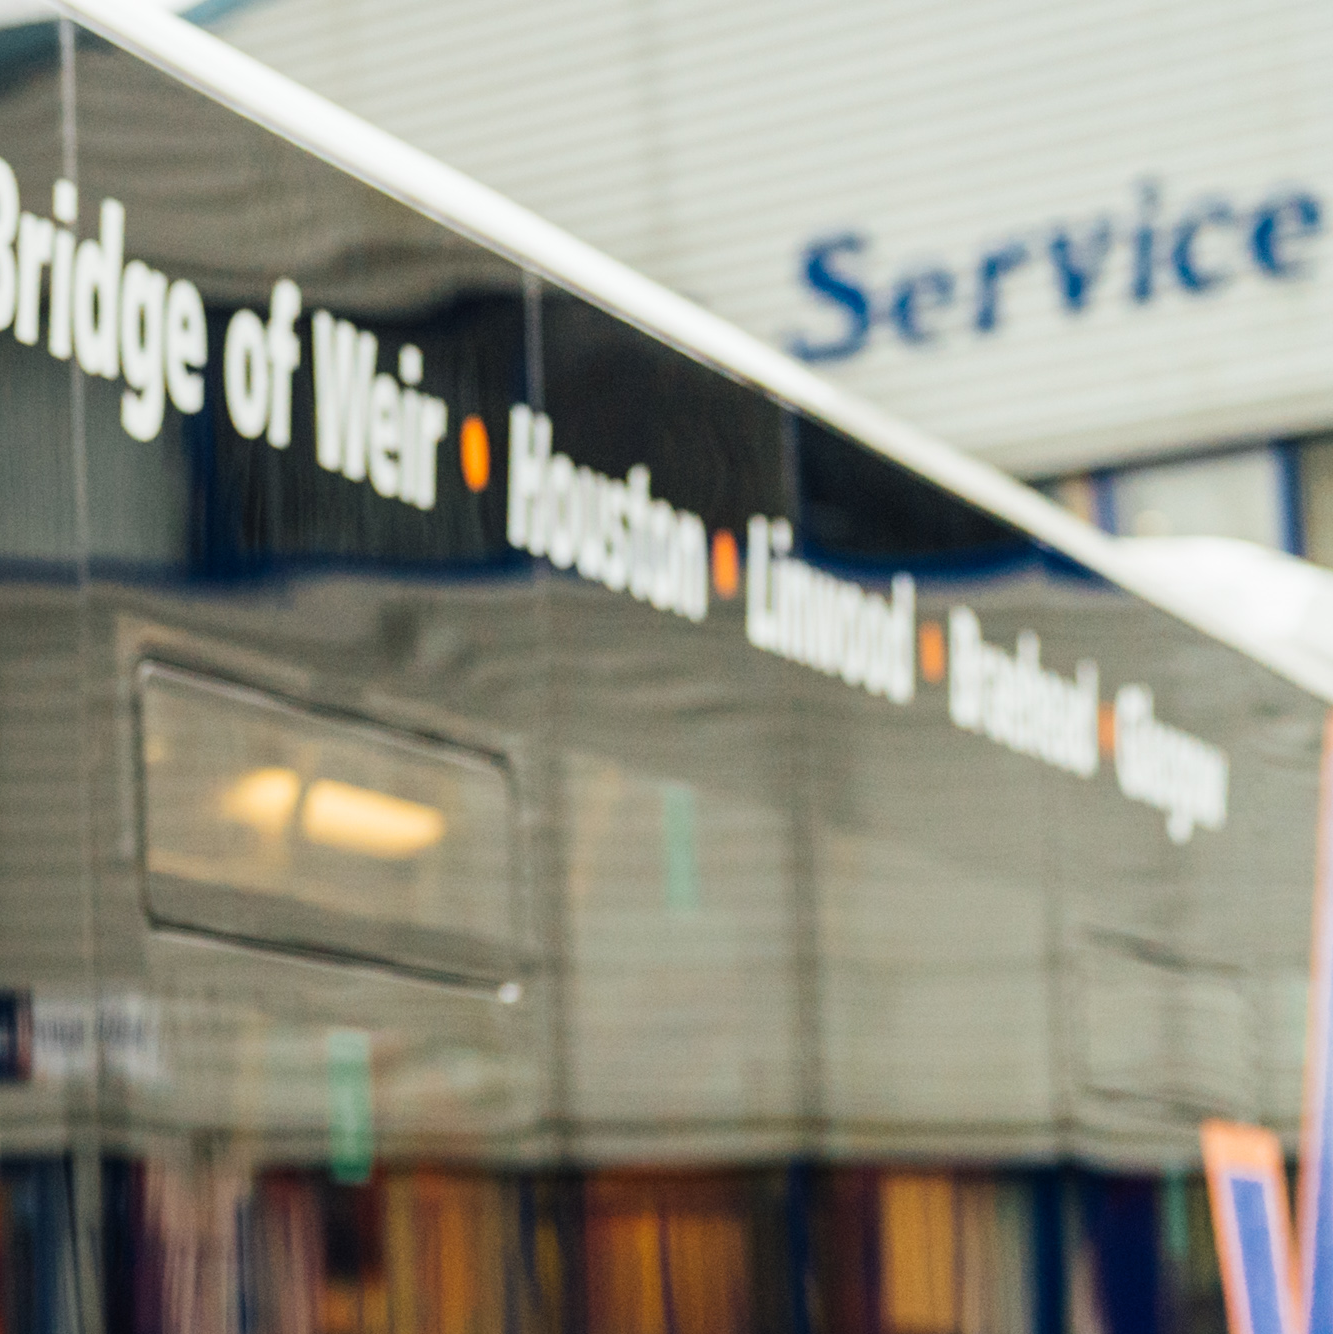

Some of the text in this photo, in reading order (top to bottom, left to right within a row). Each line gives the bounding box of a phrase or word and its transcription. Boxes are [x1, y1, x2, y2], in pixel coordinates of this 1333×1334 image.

[783, 172, 1323, 366] Service
[224, 277, 303, 450] of
[312, 309, 449, 512] Weir
[506, 402, 709, 624] Houston
[745, 512, 916, 706] Linwood
